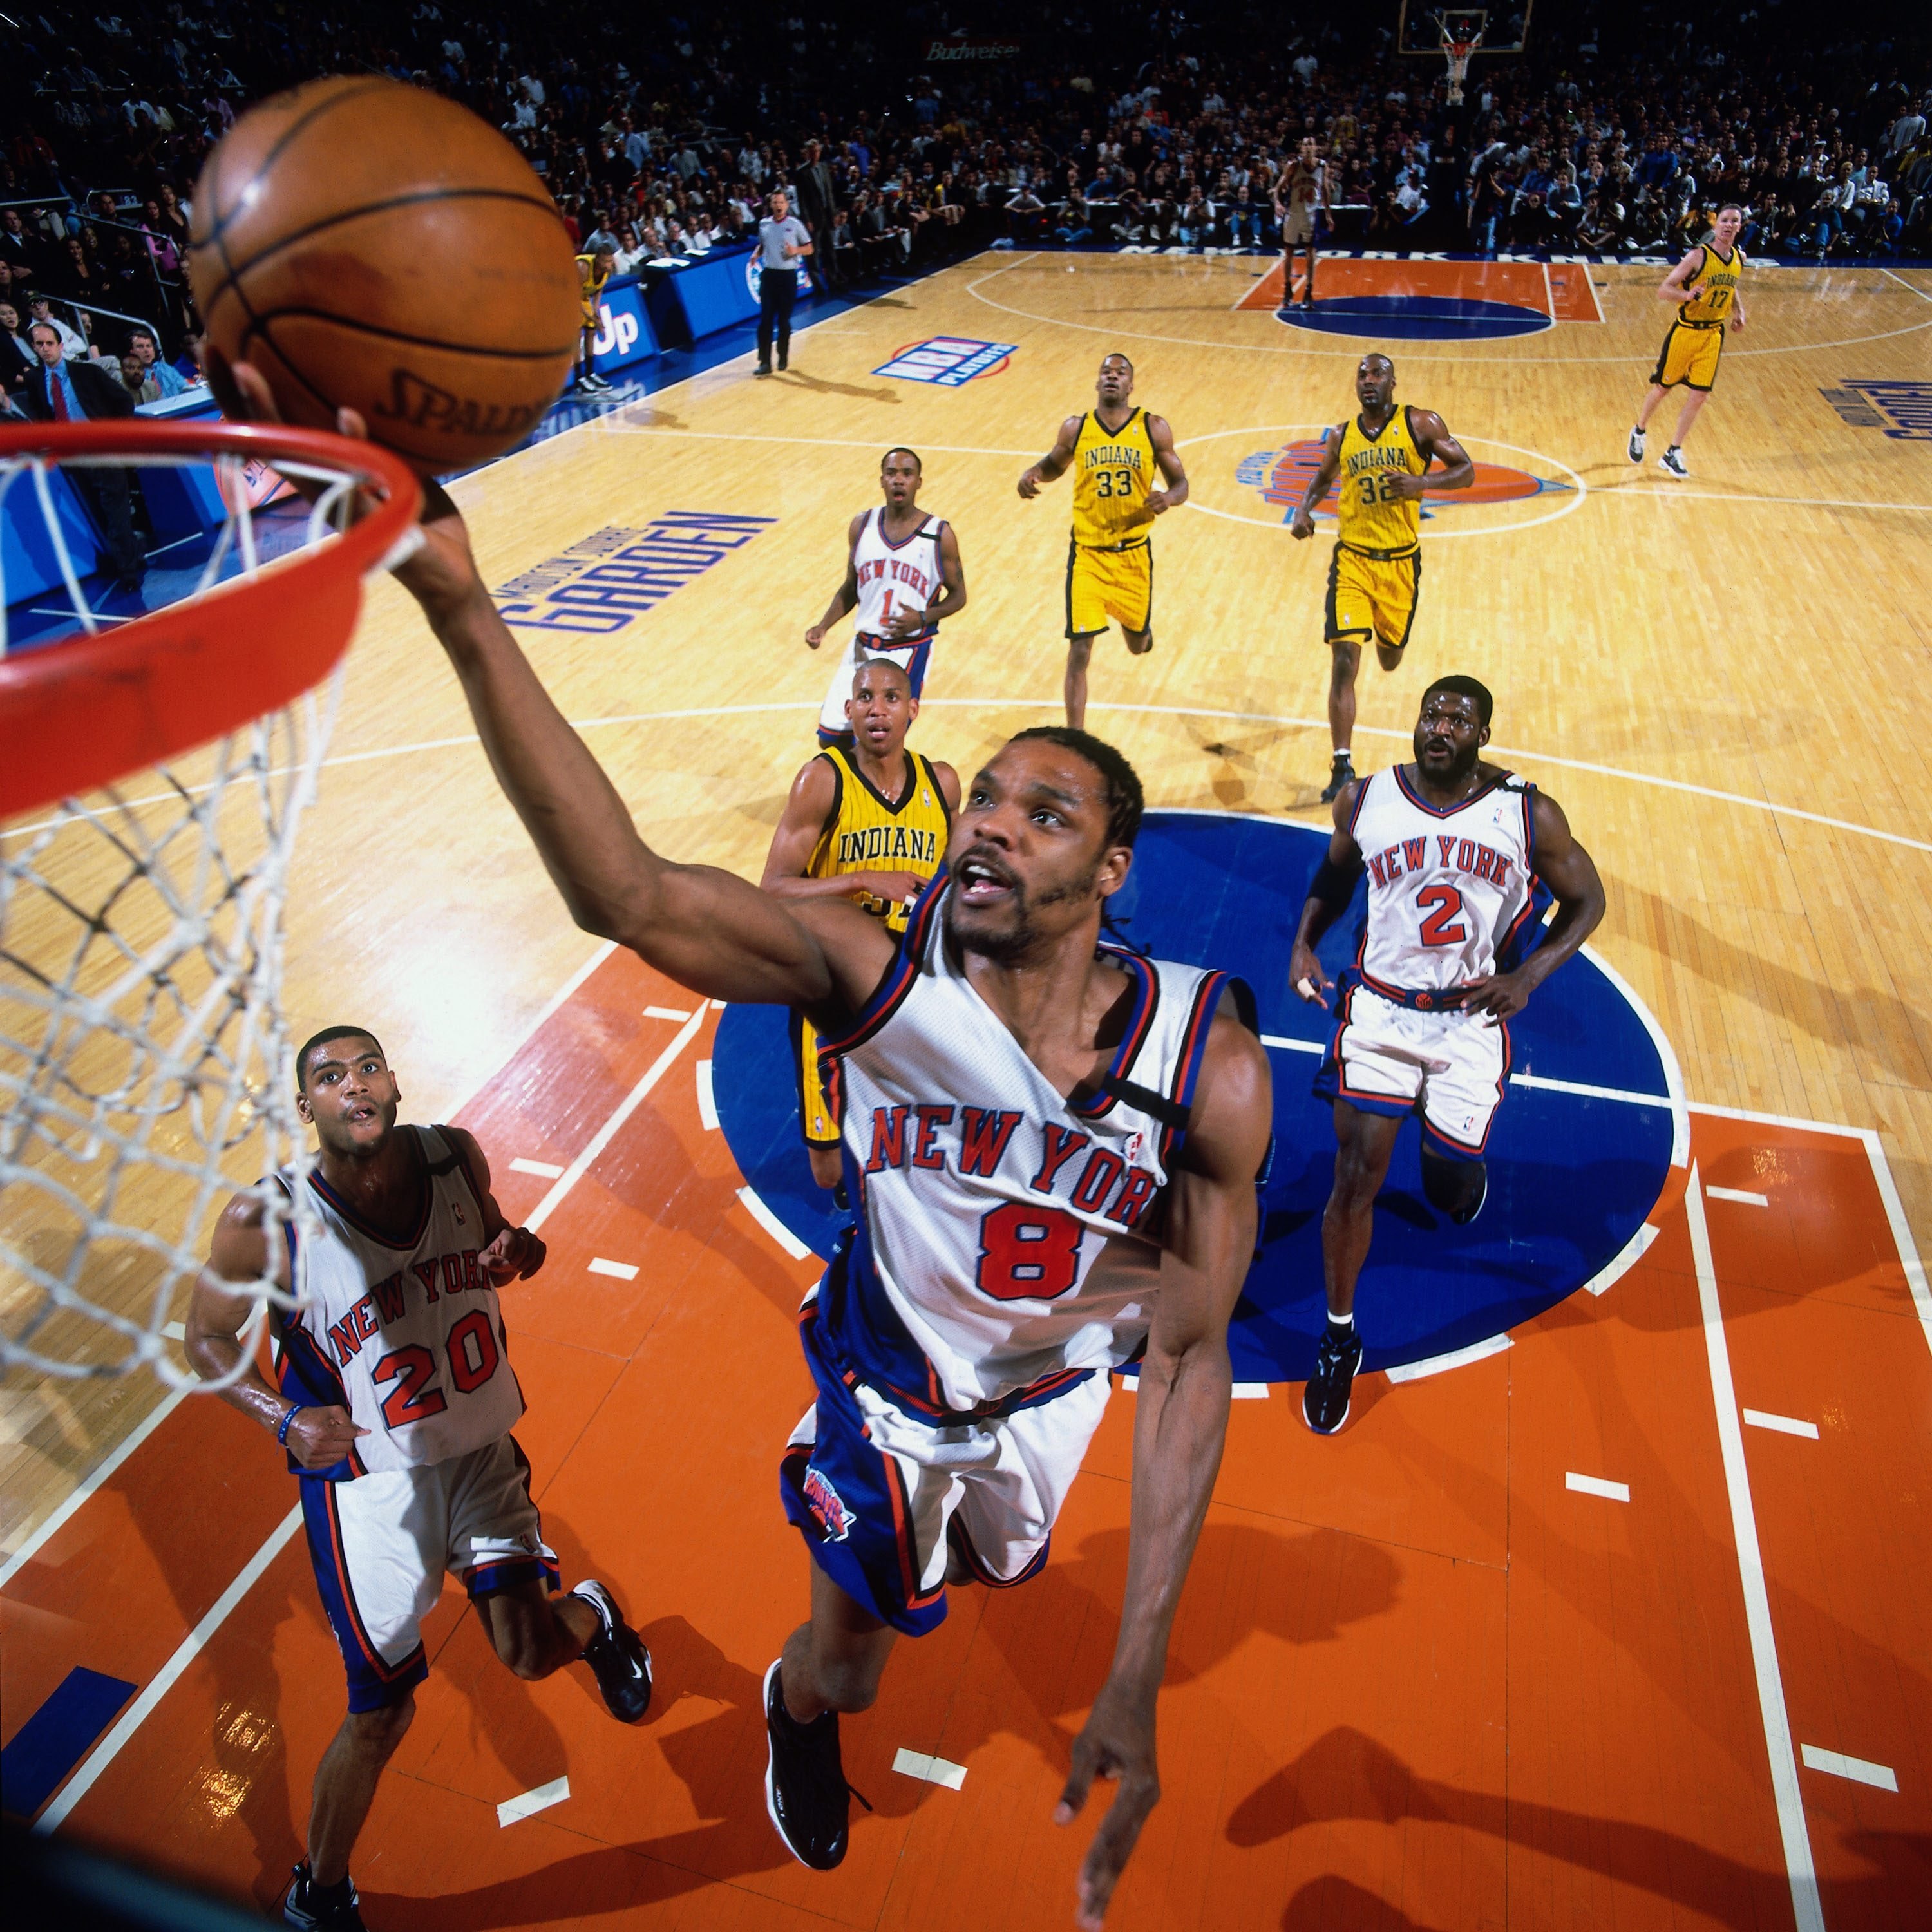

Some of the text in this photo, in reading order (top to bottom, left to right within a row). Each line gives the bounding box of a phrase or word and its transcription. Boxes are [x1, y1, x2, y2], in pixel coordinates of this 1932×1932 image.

[925, 41, 1020, 61] Budweiser
[1118, 245, 1251, 256] NEW
[1497, 254, 1783, 267] KNICS
[1707, 290, 1729, 308] 17
[579, 304, 639, 355] Up
[876, 339, 989, 381] NBA
[936, 343, 1016, 385] PLAYOFFS
[371, 366, 549, 435] SPALD
[1086, 446, 1141, 469] INDIANA
[1346, 447, 1408, 477] INDIANA
[1096, 470, 1132, 498] 33
[498, 511, 781, 634] GARDEN
[858, 558, 929, 600] NEW YORK
[879, 589, 895, 626] 1
[838, 826, 936, 863] INDIANA
[1367, 835, 1514, 891] NEW YORK
[1416, 884, 1466, 947] 2
[866, 1104, 1158, 1230] NEW YOR
[976, 1200, 1087, 1302] 8
[328, 1269, 406, 1368] NEW
[370, 1308, 500, 1430] 20
